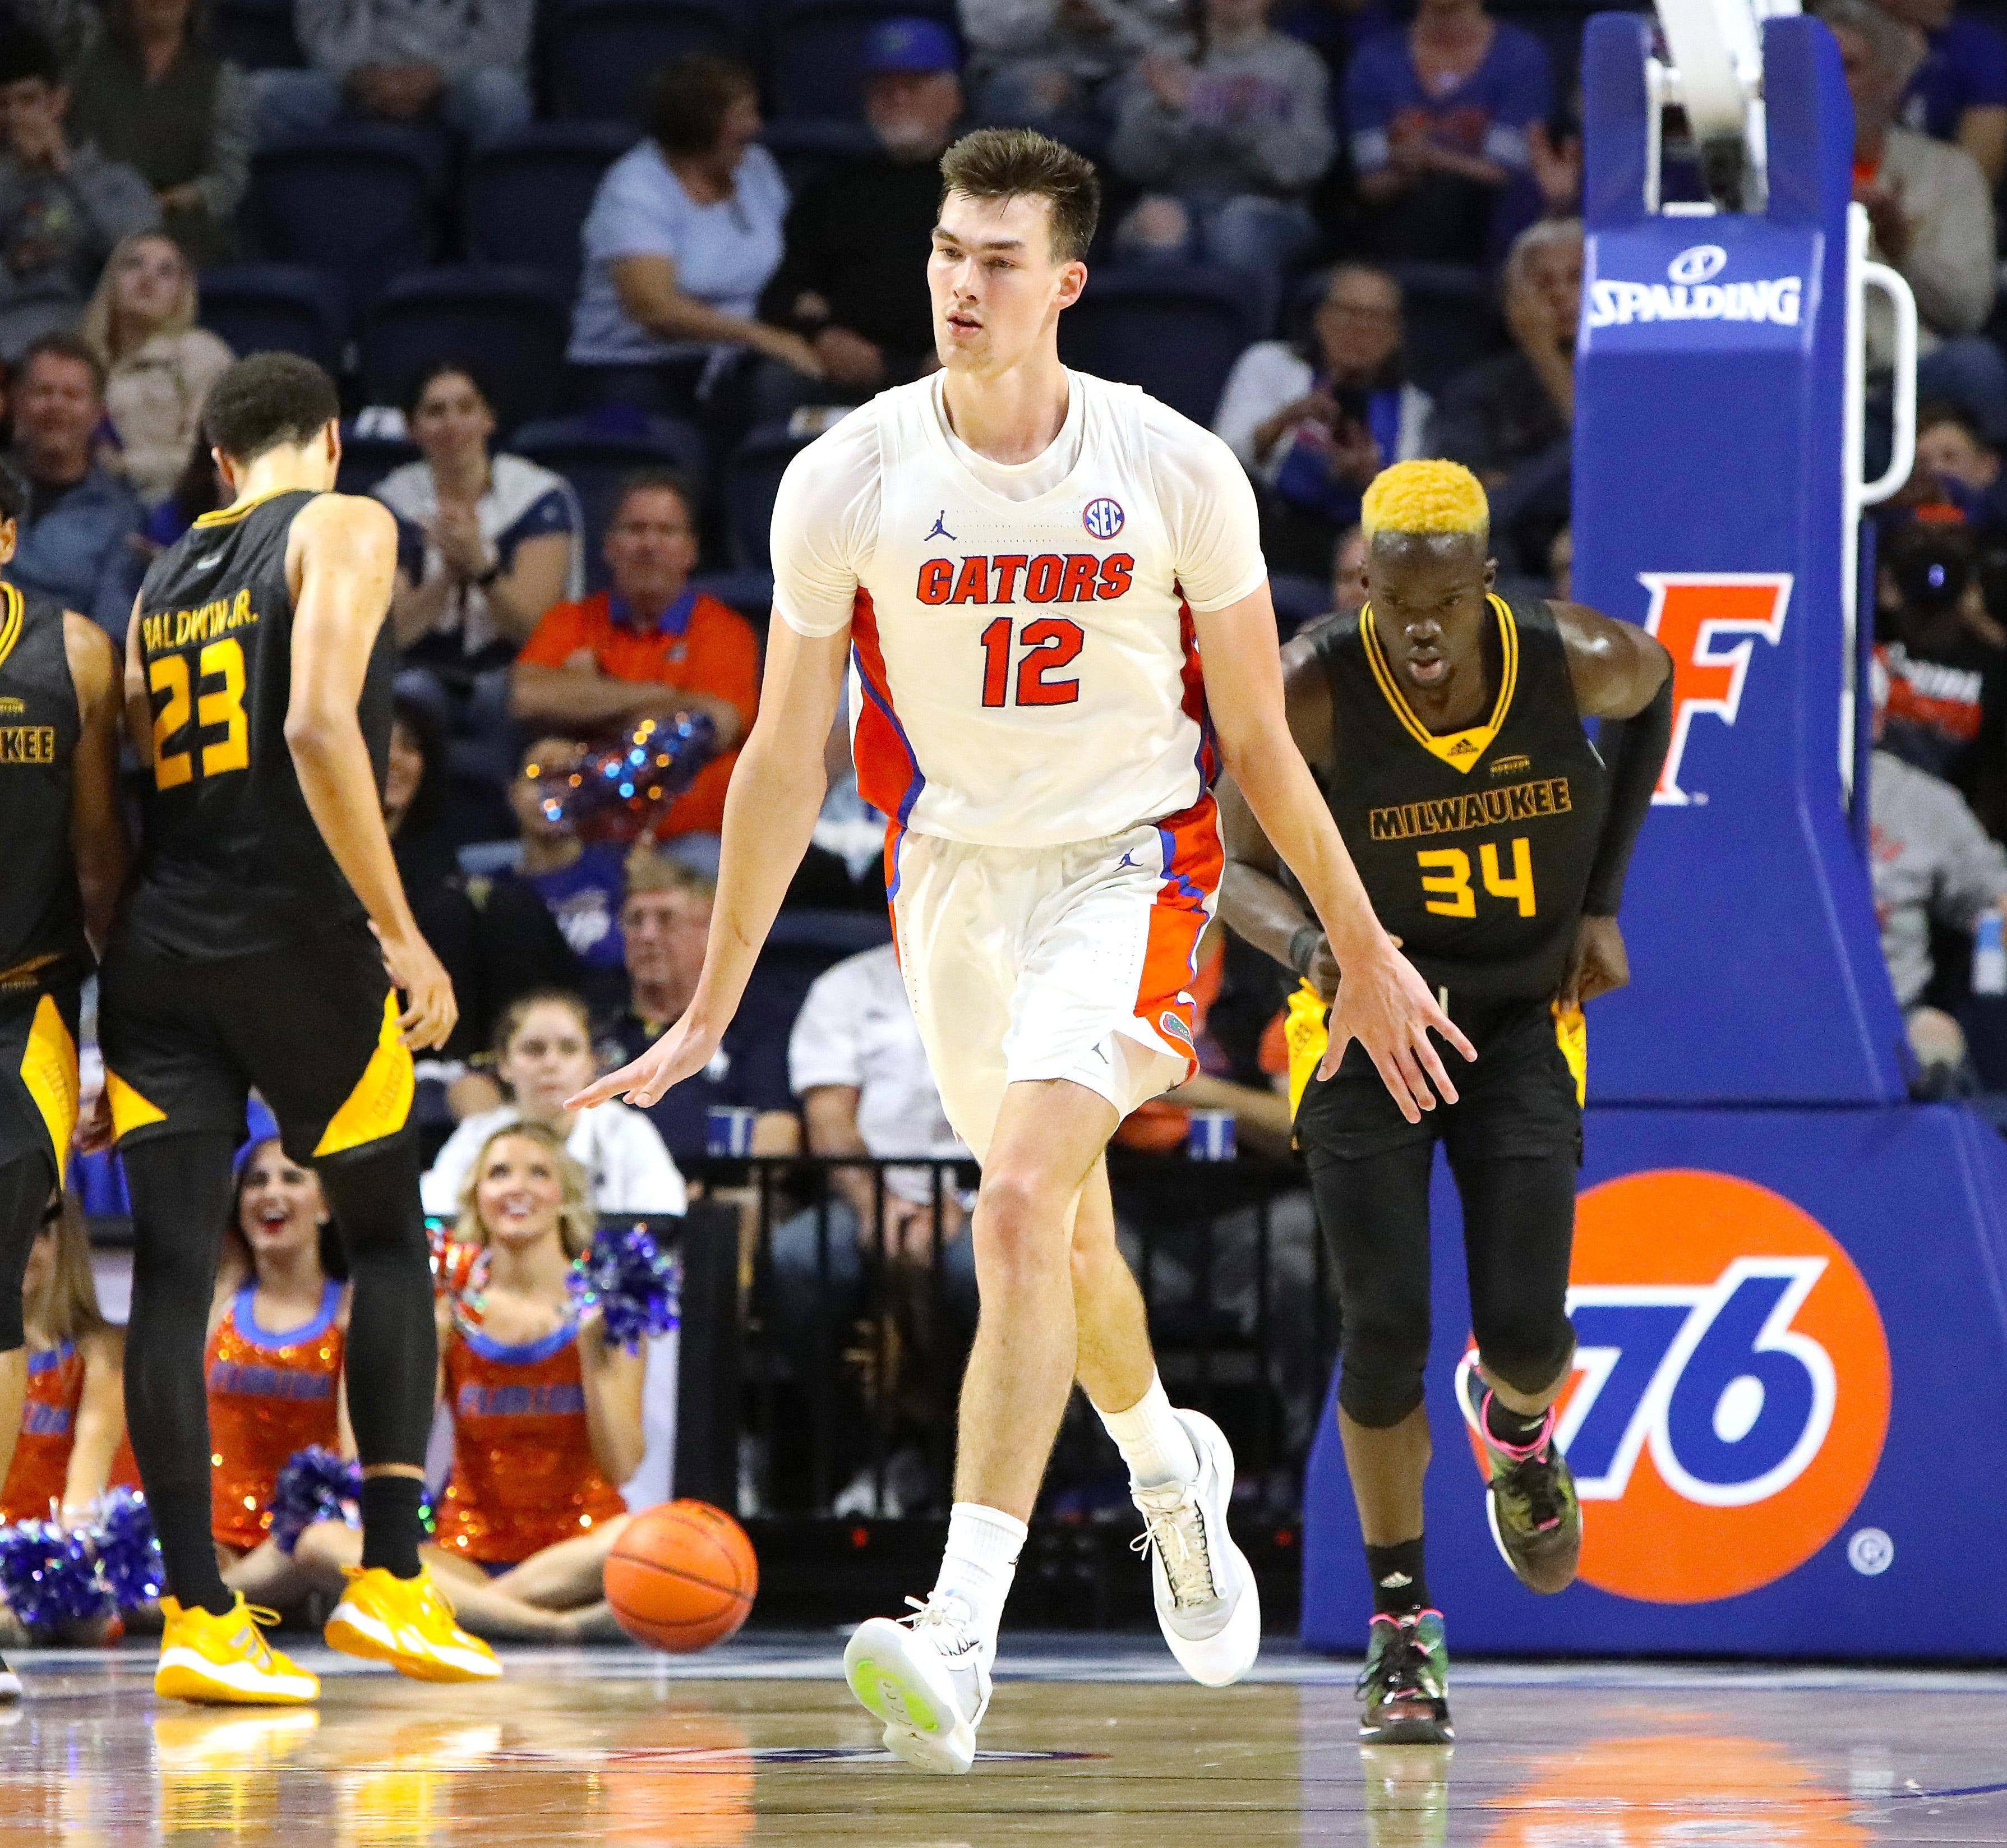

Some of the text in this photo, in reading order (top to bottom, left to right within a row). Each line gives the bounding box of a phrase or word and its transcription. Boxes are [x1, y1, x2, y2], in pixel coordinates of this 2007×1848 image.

[1586, 276, 1802, 328] SPALDING
[1085, 500, 1123, 538] SEC
[916, 552, 1136, 606] GATORS
[980, 616, 1085, 708] 12
[149, 637, 250, 790] 23
[1369, 777, 1572, 840] MILWAUKEE
[1417, 837, 1537, 919] 34
[1553, 1255, 1837, 1507] 76
